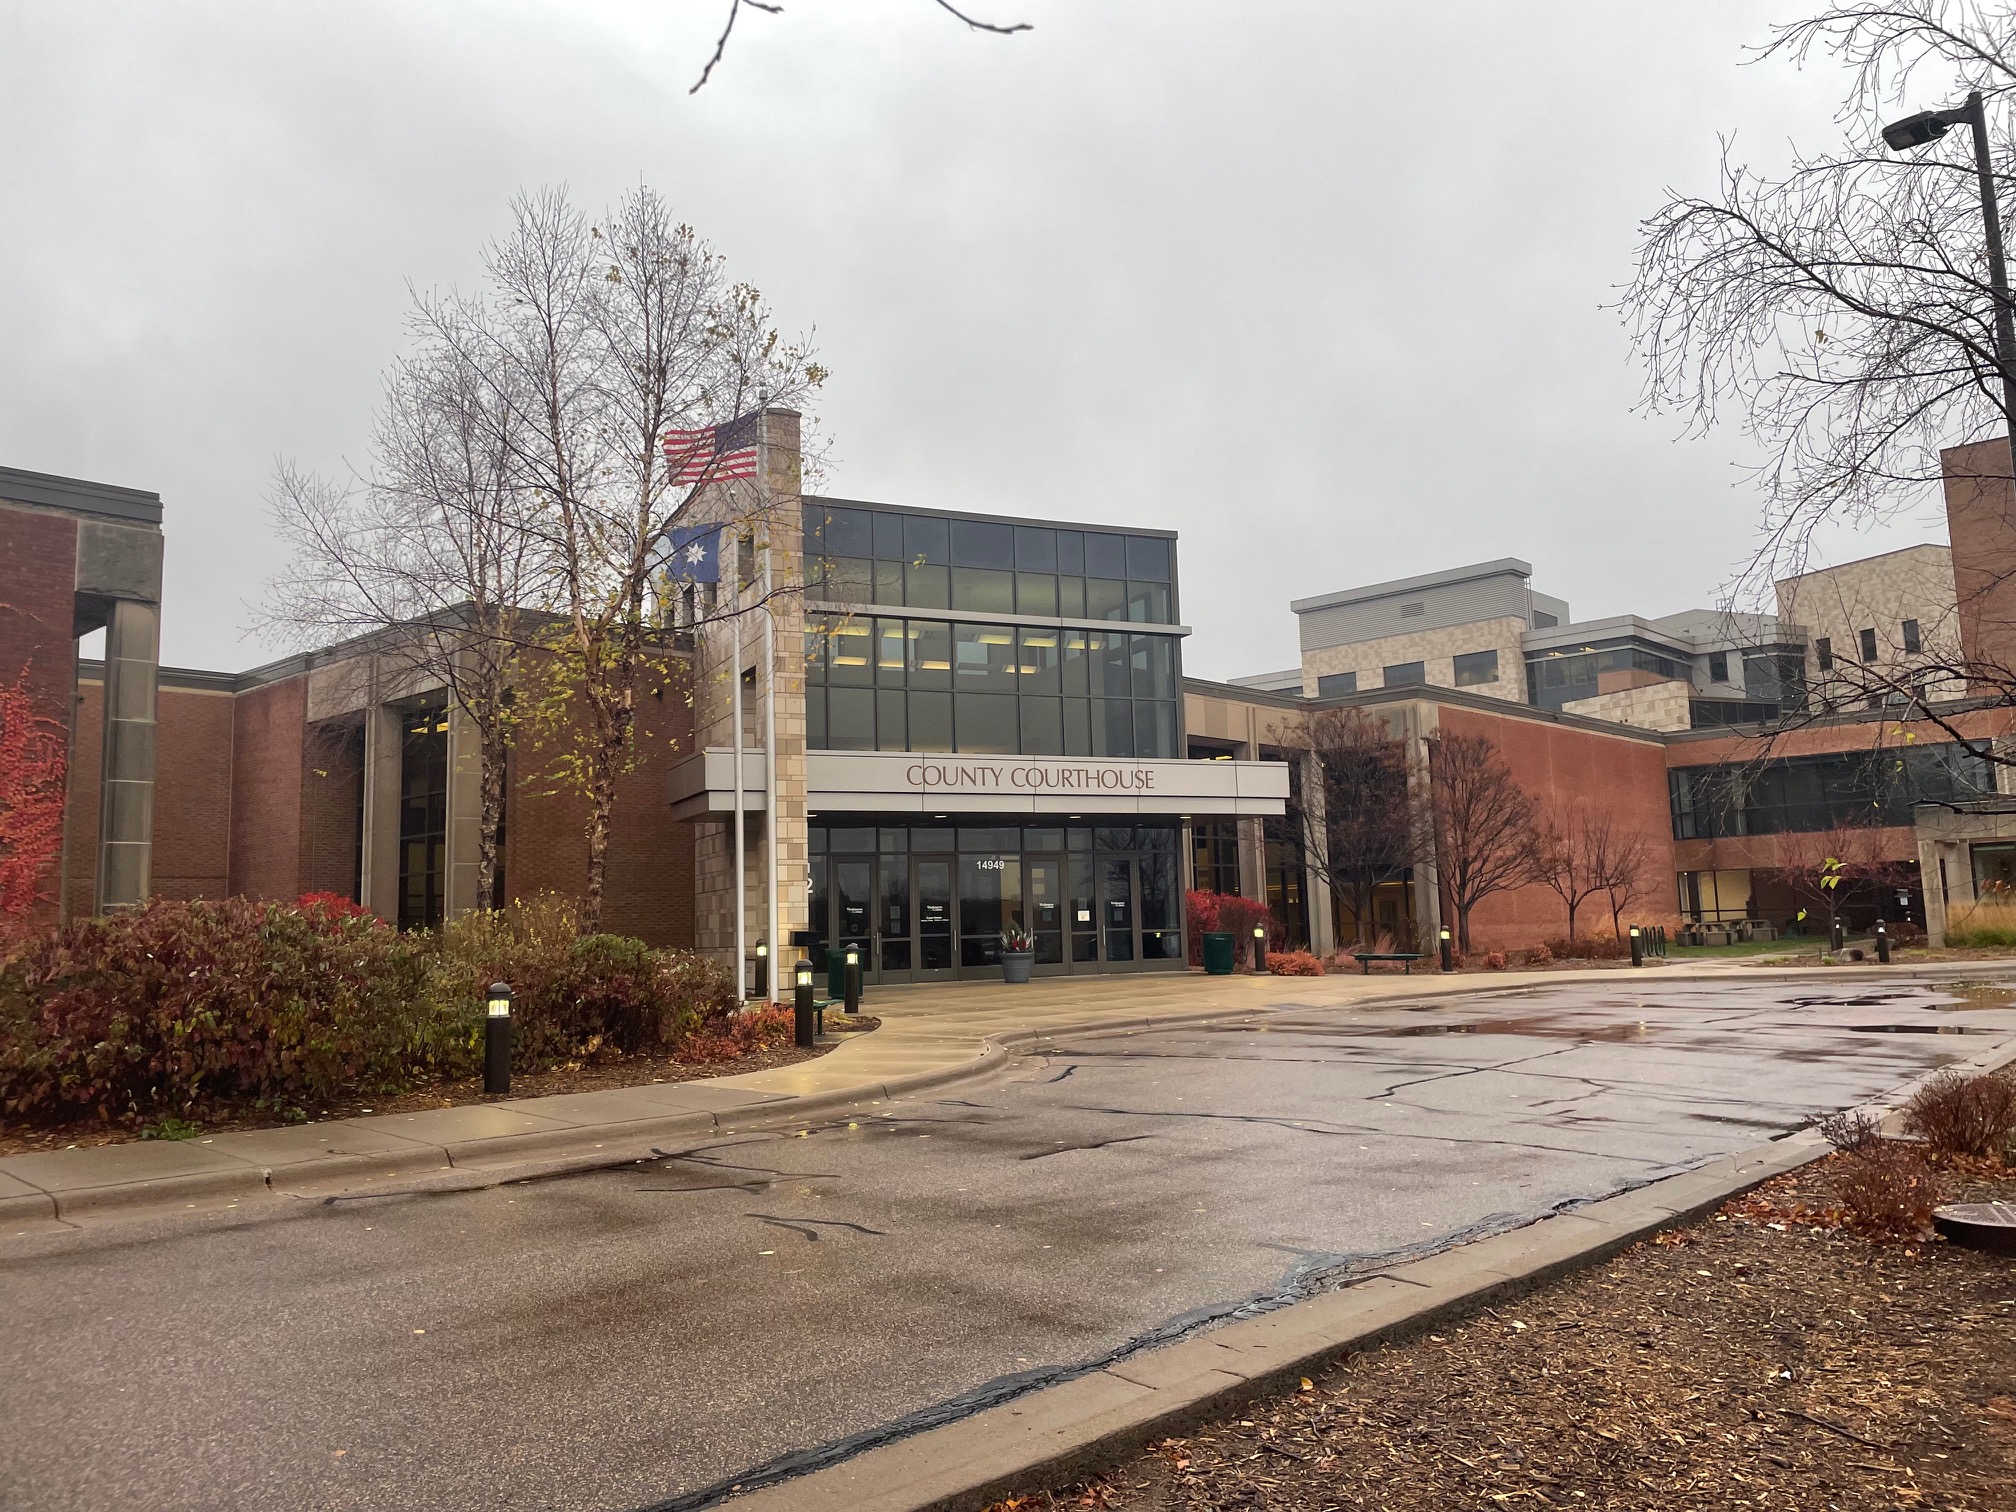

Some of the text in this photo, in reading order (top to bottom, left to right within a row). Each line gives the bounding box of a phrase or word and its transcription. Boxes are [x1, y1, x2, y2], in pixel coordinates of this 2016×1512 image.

[906, 765, 1155, 789] COUNTY COURTHOUSE
[976, 860, 1005, 870] 14949
